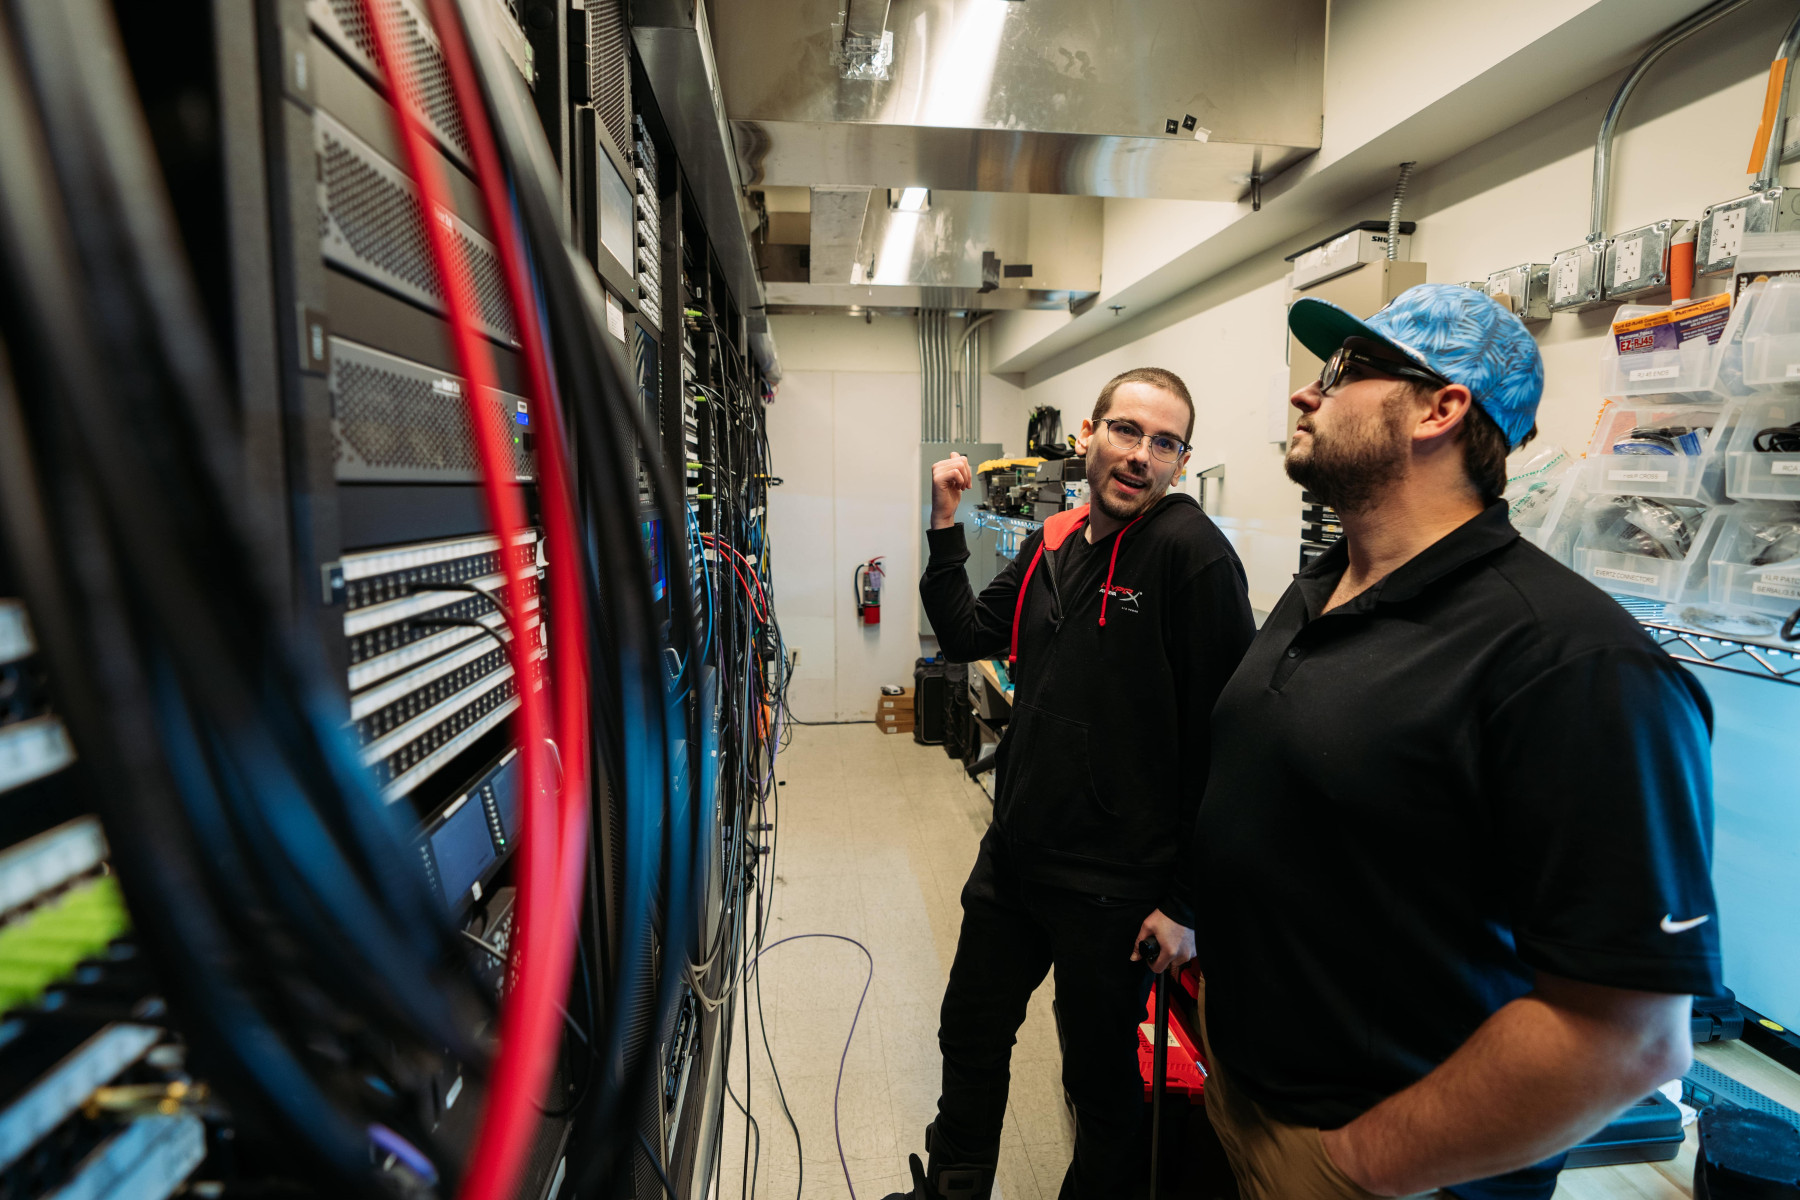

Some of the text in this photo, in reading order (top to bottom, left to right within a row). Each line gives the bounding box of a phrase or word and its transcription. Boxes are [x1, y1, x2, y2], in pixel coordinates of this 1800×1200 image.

[1371, 235, 1400, 245] SHU
[1620, 335, 1654, 352] EZ-RJ45
[1616, 572, 1655, 584] CONNECTORS
